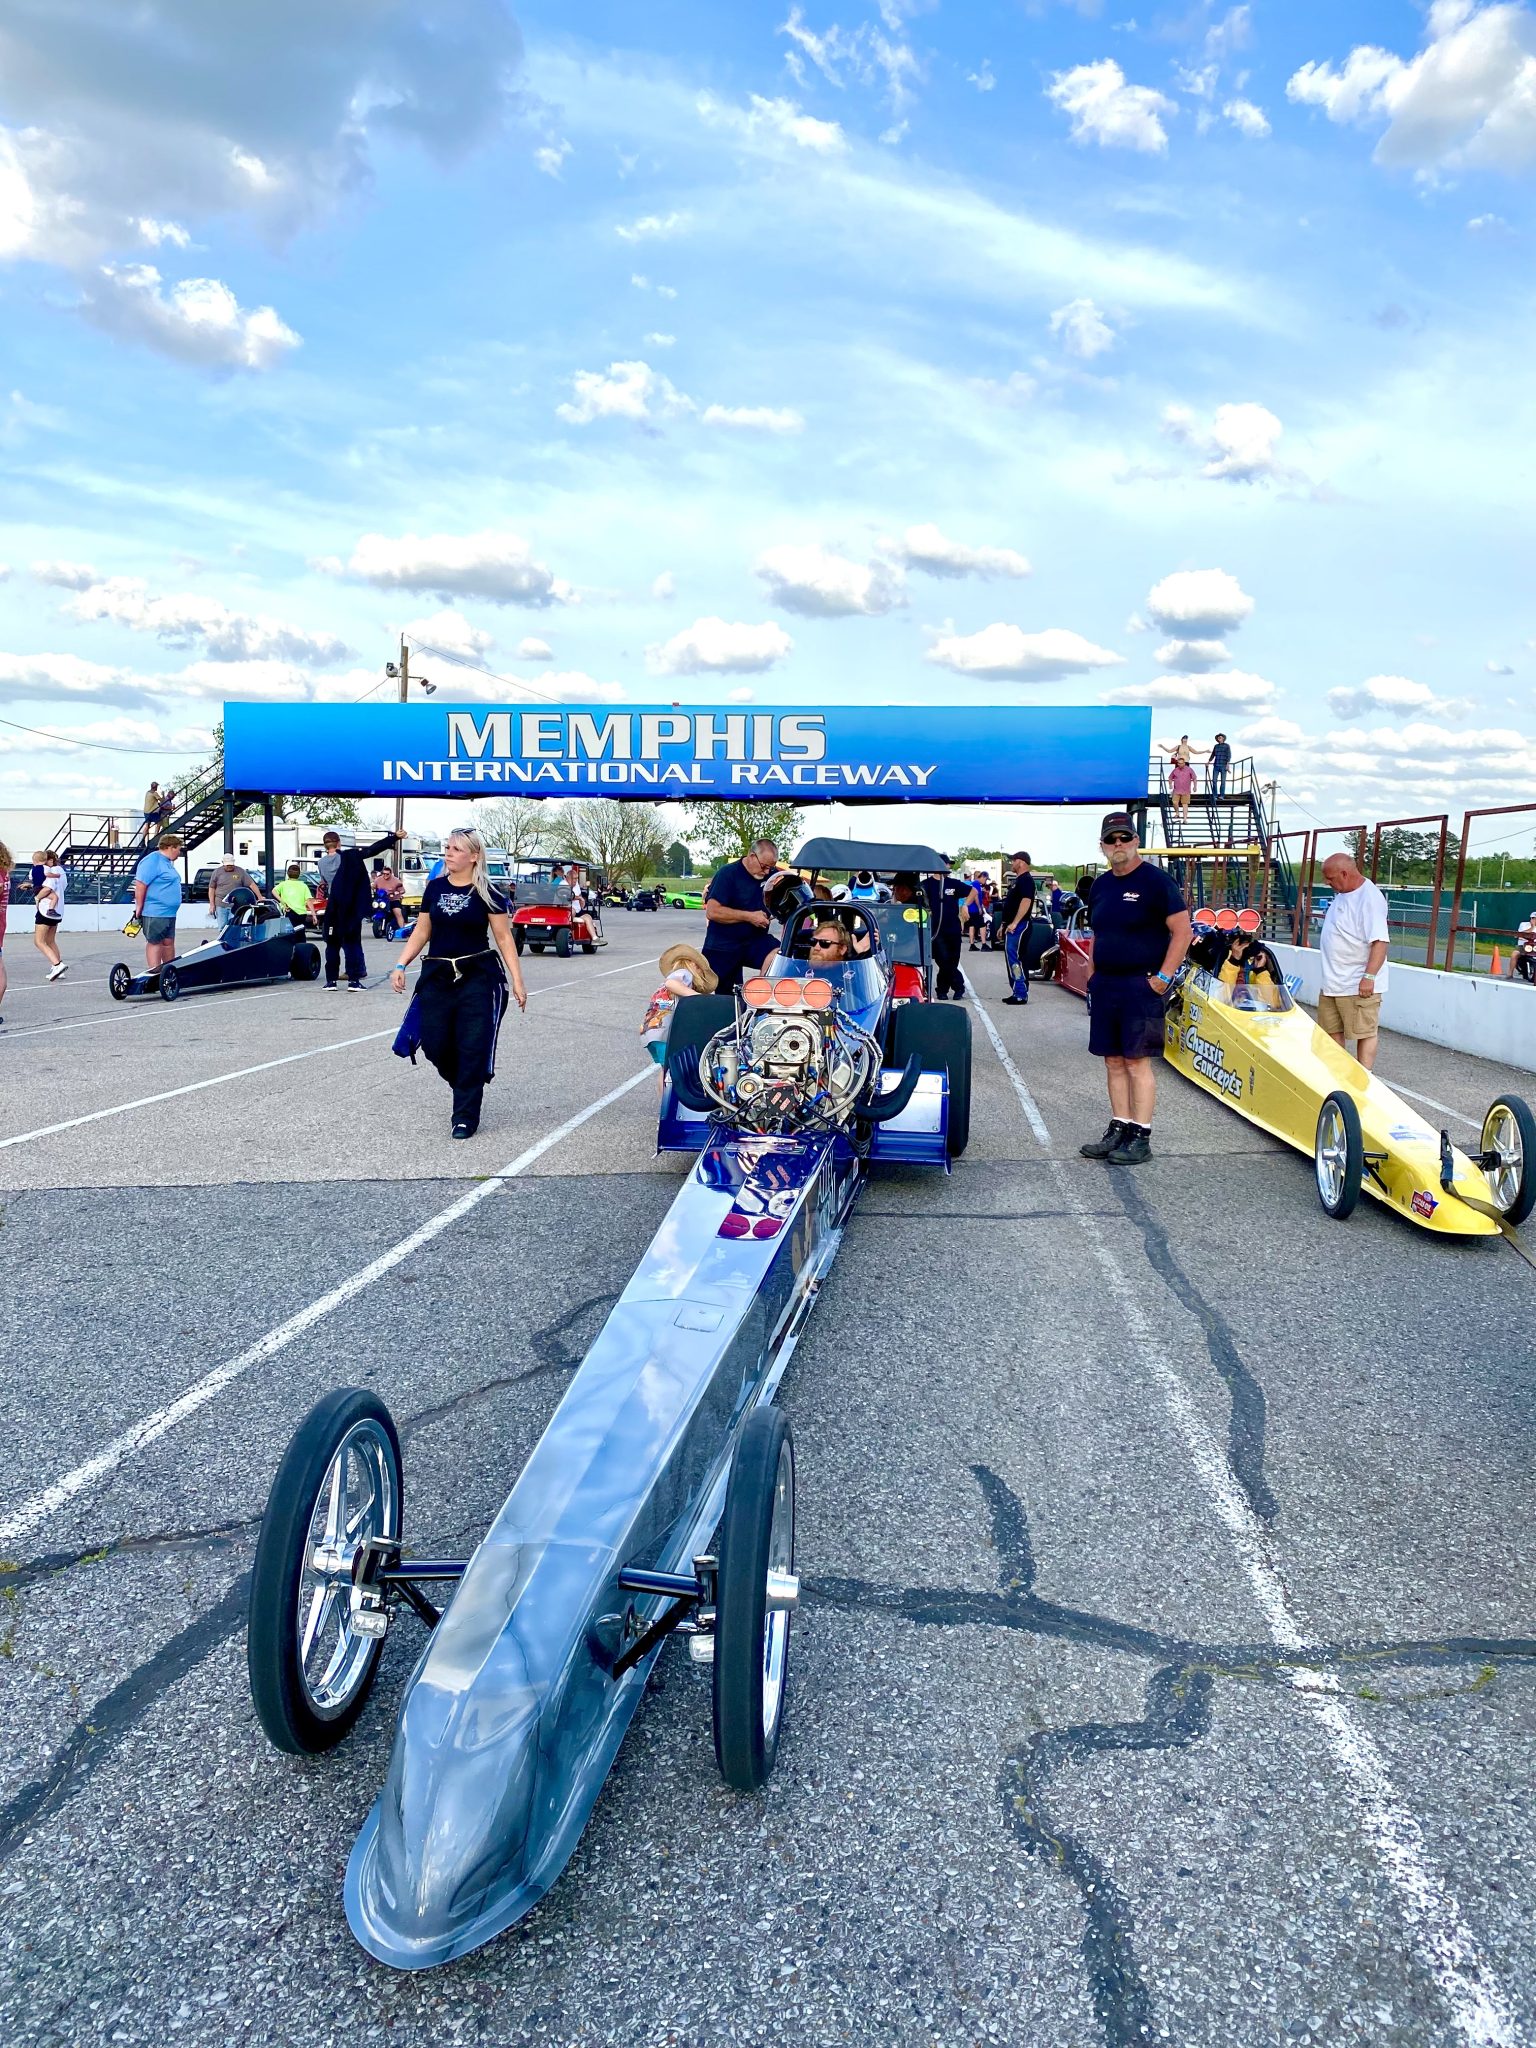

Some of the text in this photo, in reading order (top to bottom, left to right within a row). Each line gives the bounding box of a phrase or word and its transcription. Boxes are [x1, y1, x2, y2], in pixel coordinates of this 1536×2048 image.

[447, 713, 826, 761] MEMPHIS
[382, 761, 938, 786] INTERNATIONAL RACEWAY
[1185, 1025, 1224, 1067] Chassis
[1193, 1055, 1242, 1099] Concepts
